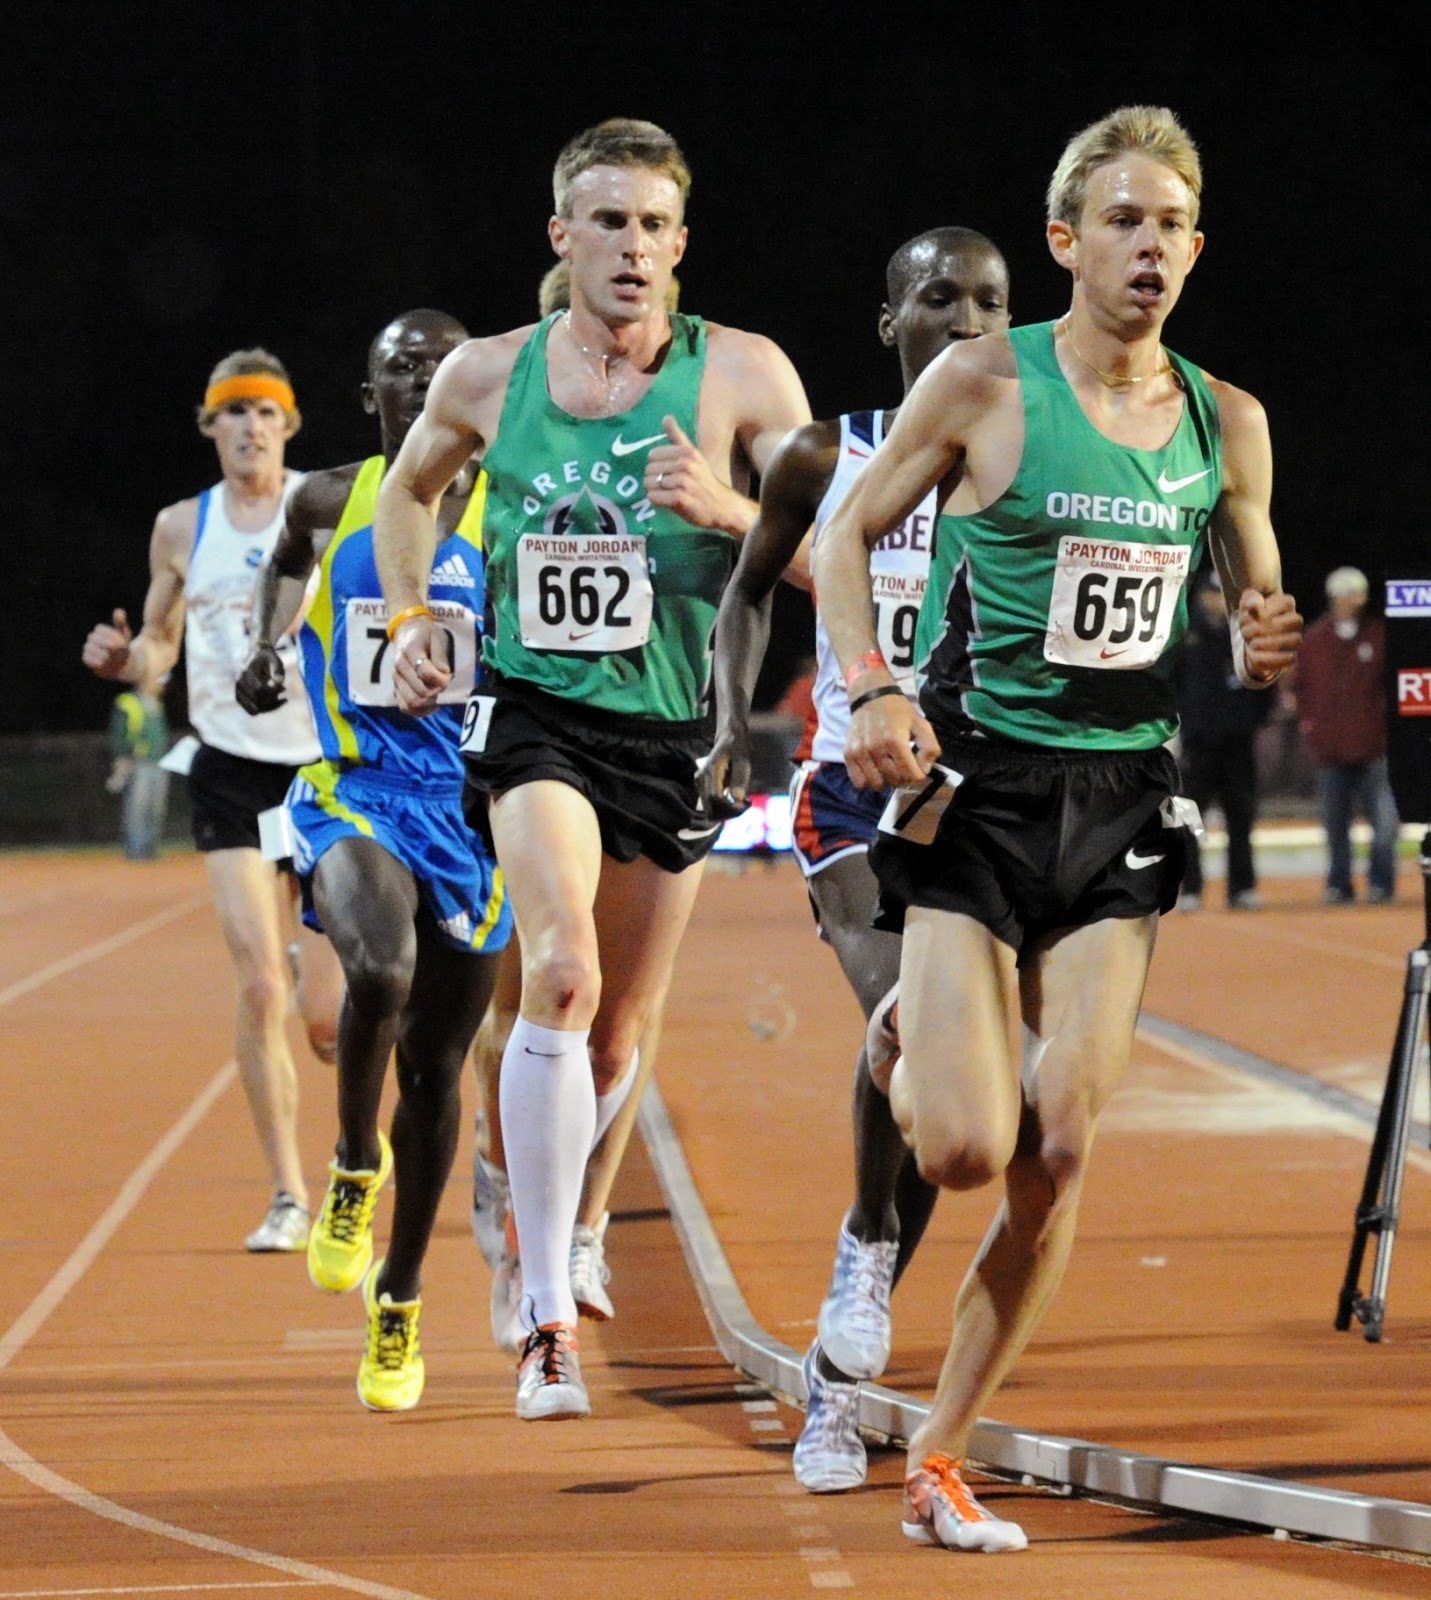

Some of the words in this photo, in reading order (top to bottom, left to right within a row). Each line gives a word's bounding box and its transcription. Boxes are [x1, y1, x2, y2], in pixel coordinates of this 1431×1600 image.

[523, 461, 656, 522] OREGON
[526, 539, 577, 553] PAYTON
[583, 540, 639, 553] JORDAN
[1070, 543, 1131, 562] PAYTON
[1136, 549, 1183, 565] JORDAN
[1091, 561, 1126, 571] CARDINAL
[539, 565, 632, 627] 662
[1073, 573, 1163, 644] 659
[460, 700, 480, 746] 9
